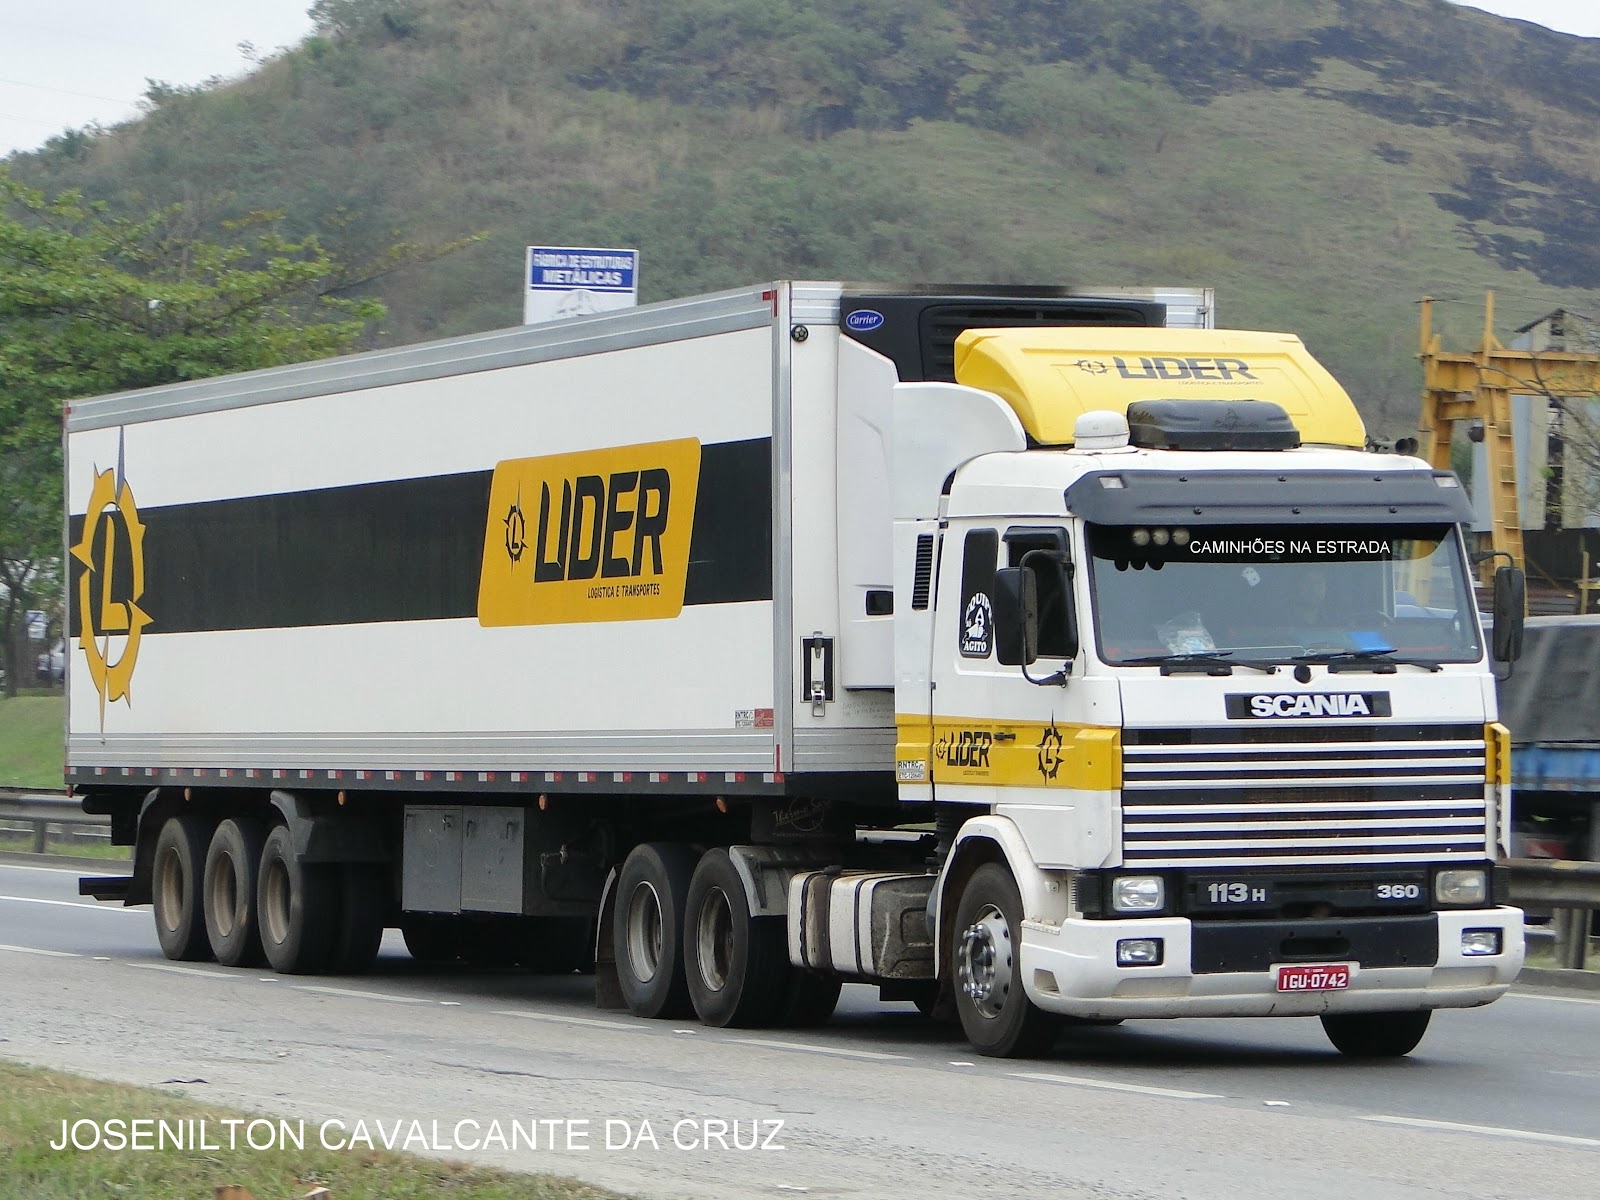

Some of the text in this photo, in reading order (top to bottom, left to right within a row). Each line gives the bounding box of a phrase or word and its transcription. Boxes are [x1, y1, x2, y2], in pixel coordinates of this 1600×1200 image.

[542, 268, 622, 285] METÁLICAS
[850, 314, 878, 325] Carrier
[1112, 356, 1260, 380] LIDER
[534, 468, 671, 583] LIDER
[616, 585, 620, 597] E
[622, 583, 660, 597] TRANSPORTES
[963, 640, 987, 652] AGITO
[1250, 694, 1370, 717] SCANIA
[947, 731, 992, 768] LIDER
[1208, 882, 1266, 903] 113 H
[1377, 884, 1420, 900] 360
